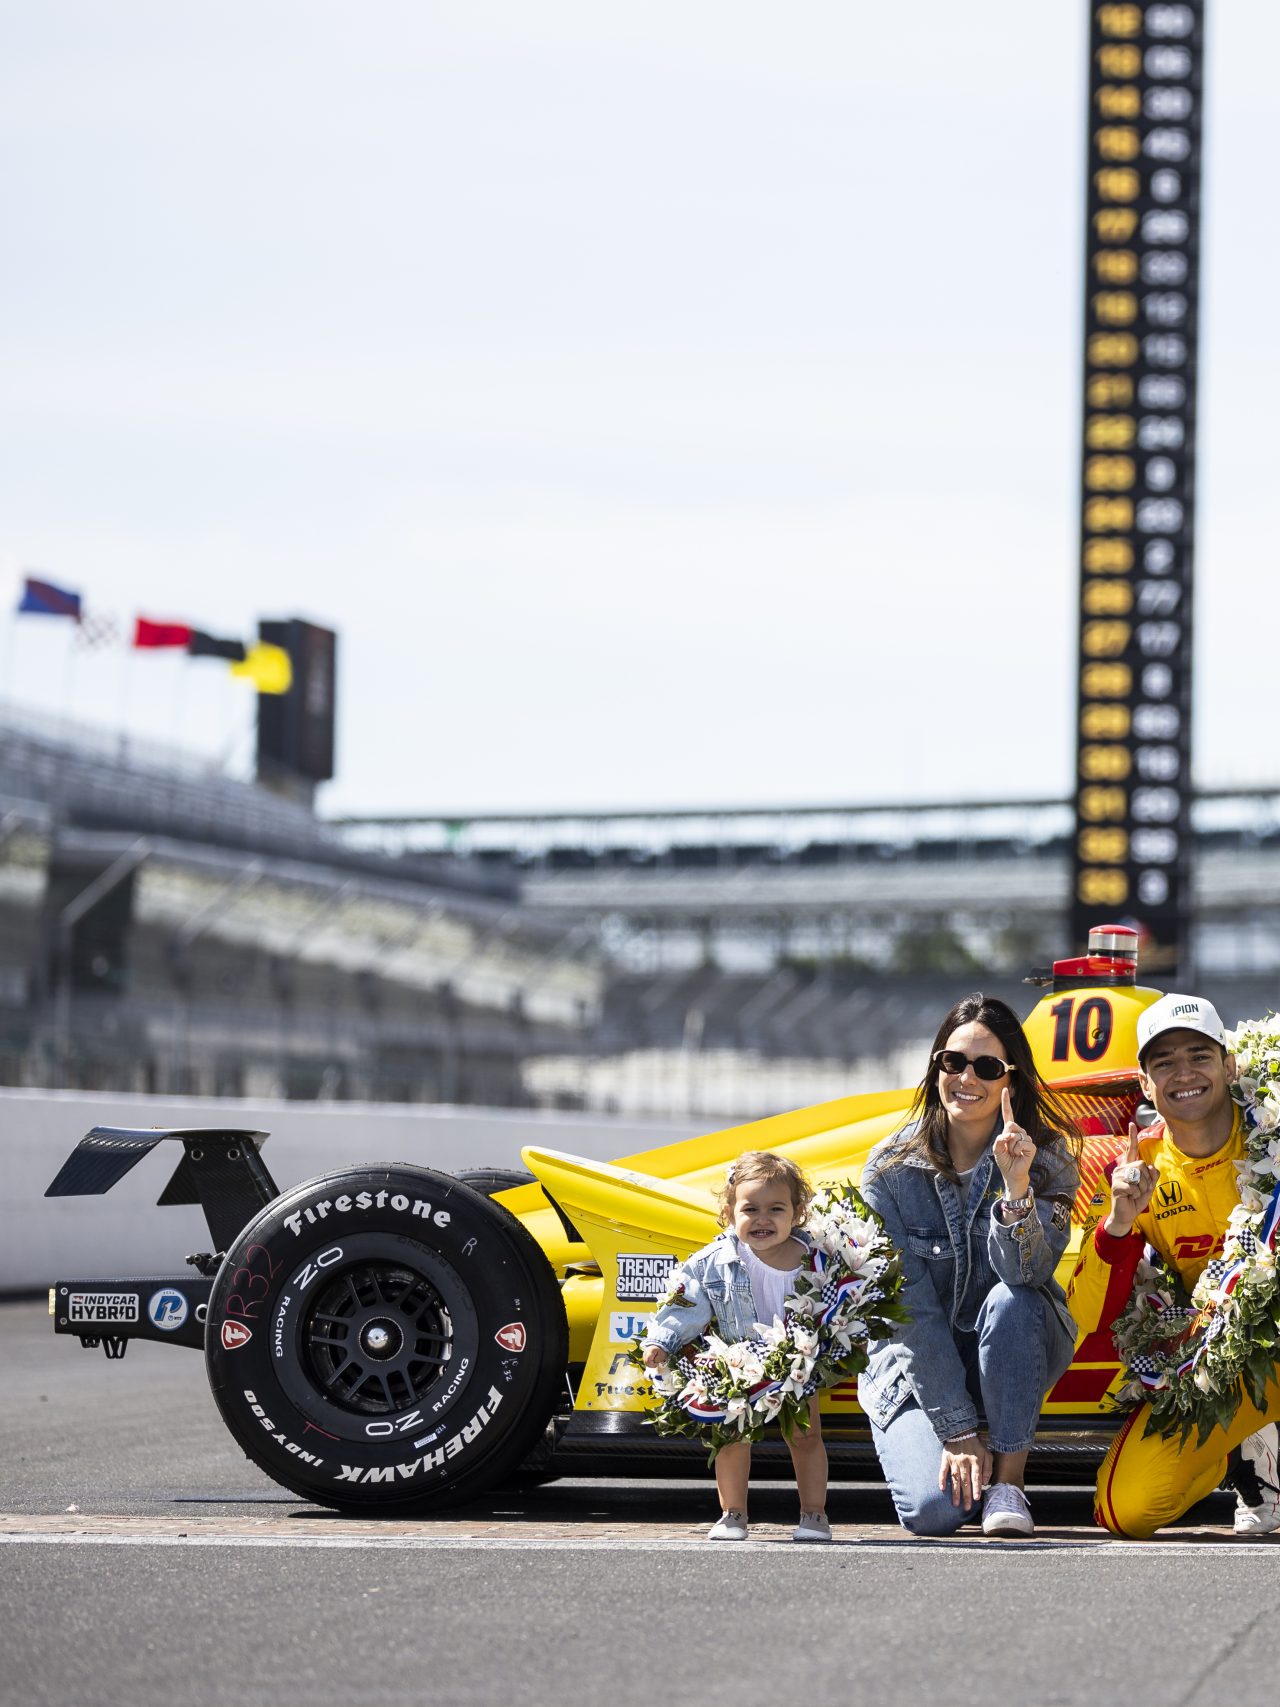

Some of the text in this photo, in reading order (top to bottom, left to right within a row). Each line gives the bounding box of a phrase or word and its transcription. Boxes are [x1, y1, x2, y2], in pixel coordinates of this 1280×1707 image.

[1051, 996, 1114, 1062] 10
[284, 1189, 451, 1237] Firestone
[226, 1243, 284, 1319] R32
[616, 1258, 674, 1277] TRENCH
[616, 1277, 669, 1293] SHORIN
[71, 1306, 136, 1320] HYBRID
[84, 1295, 136, 1305] INDYCAR
[275, 1295, 291, 1358] RACING
[432, 1357, 470, 1412] RACING
[243, 1390, 276, 1431] 500
[272, 1433, 324, 1467] INDY
[333, 1385, 504, 1484] FIREHAWK
